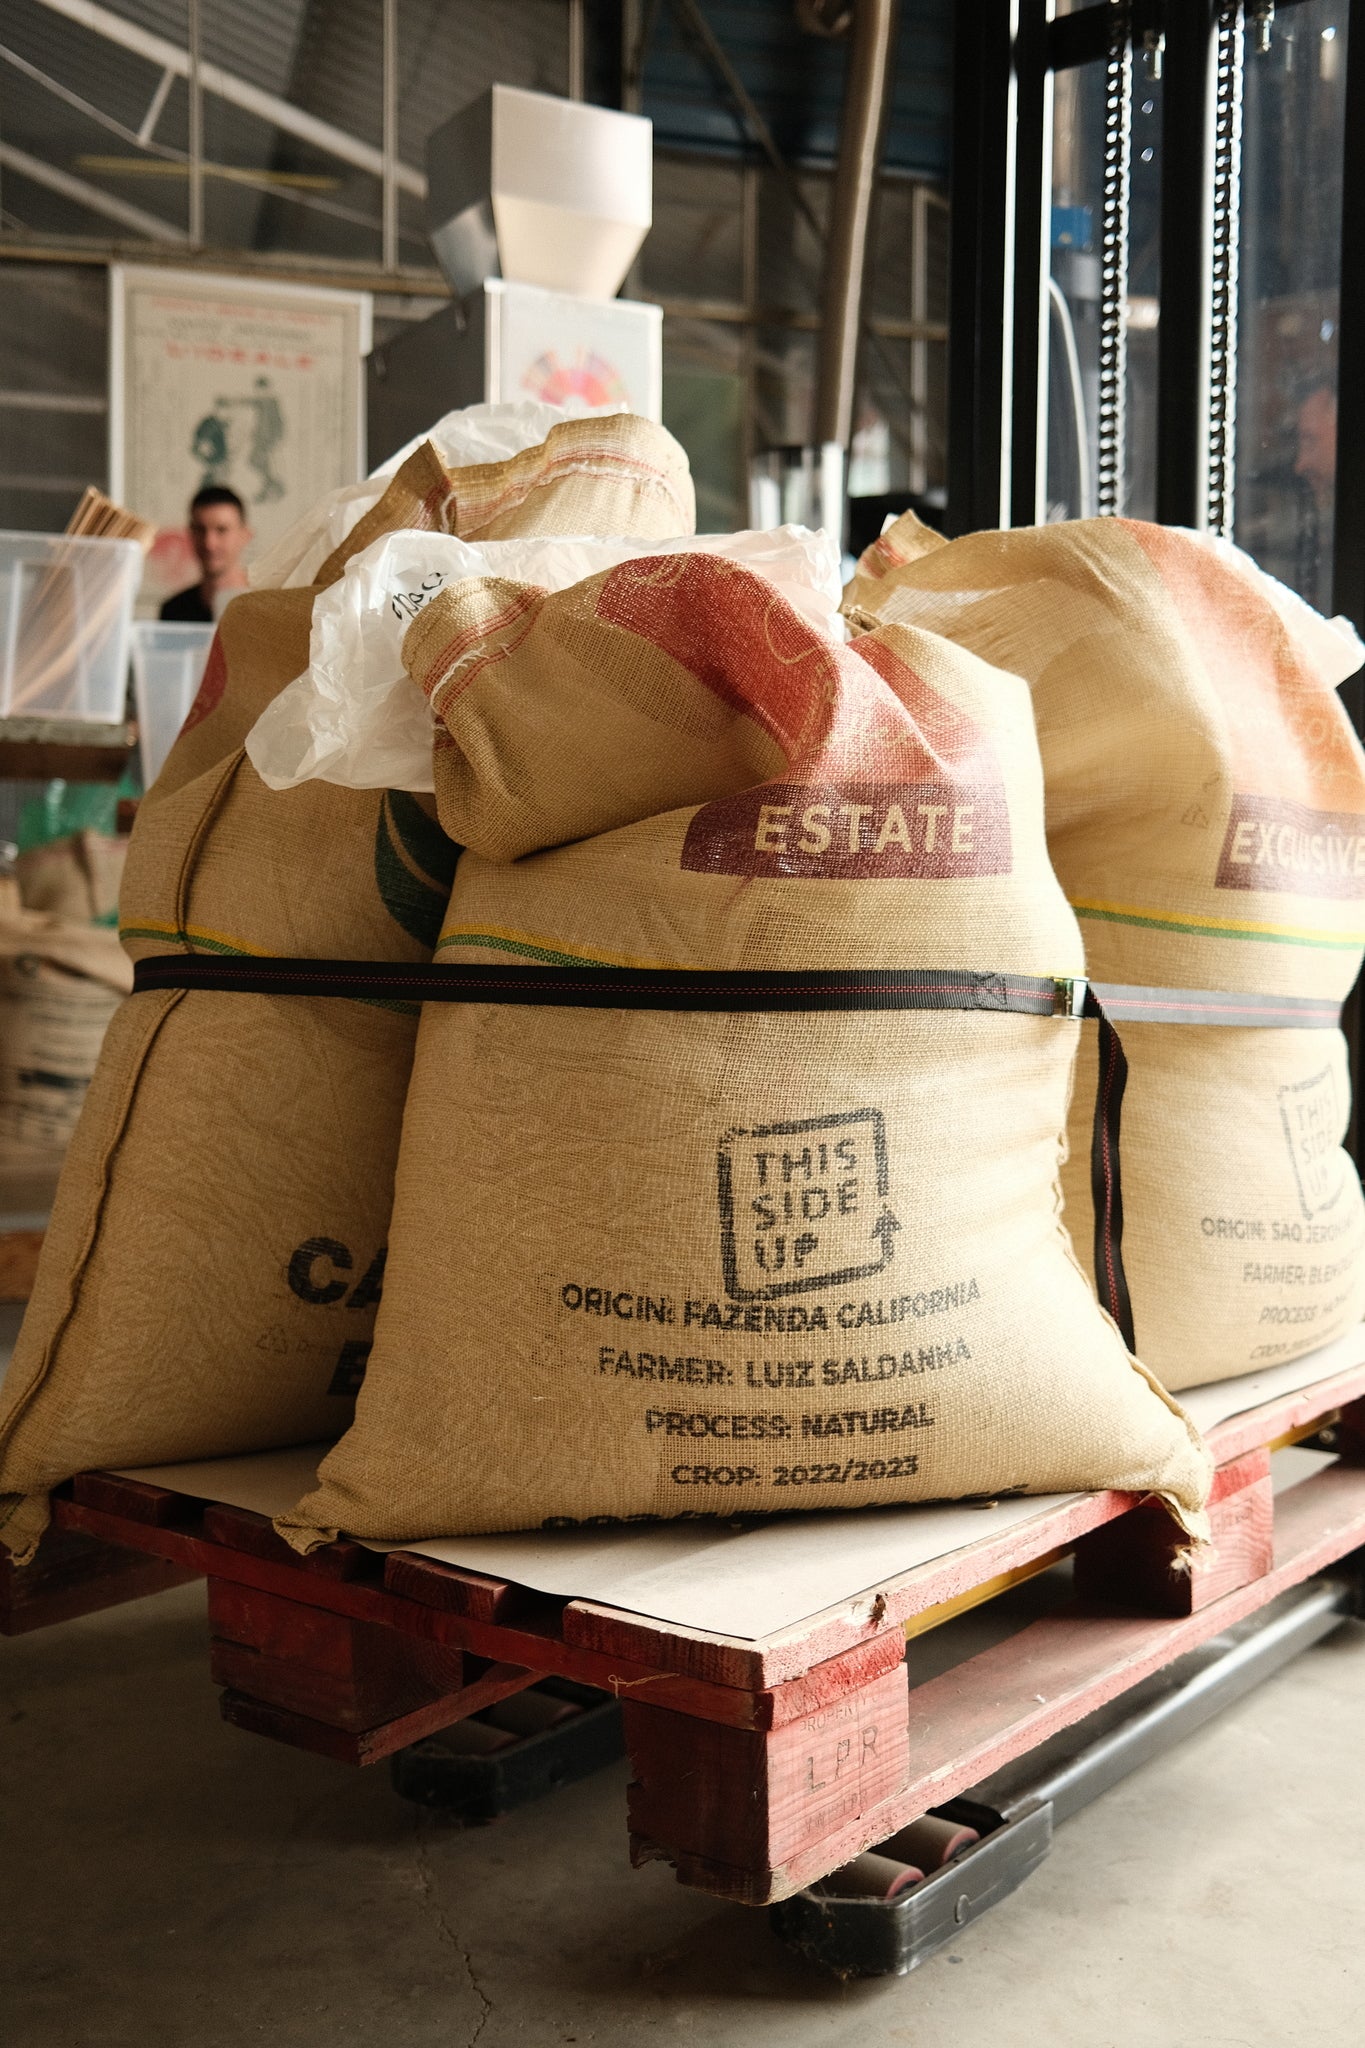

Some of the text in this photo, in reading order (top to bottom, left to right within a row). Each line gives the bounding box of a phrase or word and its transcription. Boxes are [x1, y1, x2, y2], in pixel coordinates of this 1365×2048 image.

[754, 803, 975, 855] ESTATE
[753, 1138, 858, 1187] THIS
[752, 1178, 858, 1230] SIDE
[755, 1232, 819, 1272] UP
[1201, 1217, 1267, 1241] ORIGIN:
[562, 1278, 981, 1332] ORIGIN: FAZENDA CALIFORNIA
[600, 1337, 971, 1388] FARMER: LUIZ SALDANHA
[645, 1402, 935, 1440] PROCESS: NATURAL
[671, 1454, 919, 1487] CROP: 2022/2023
